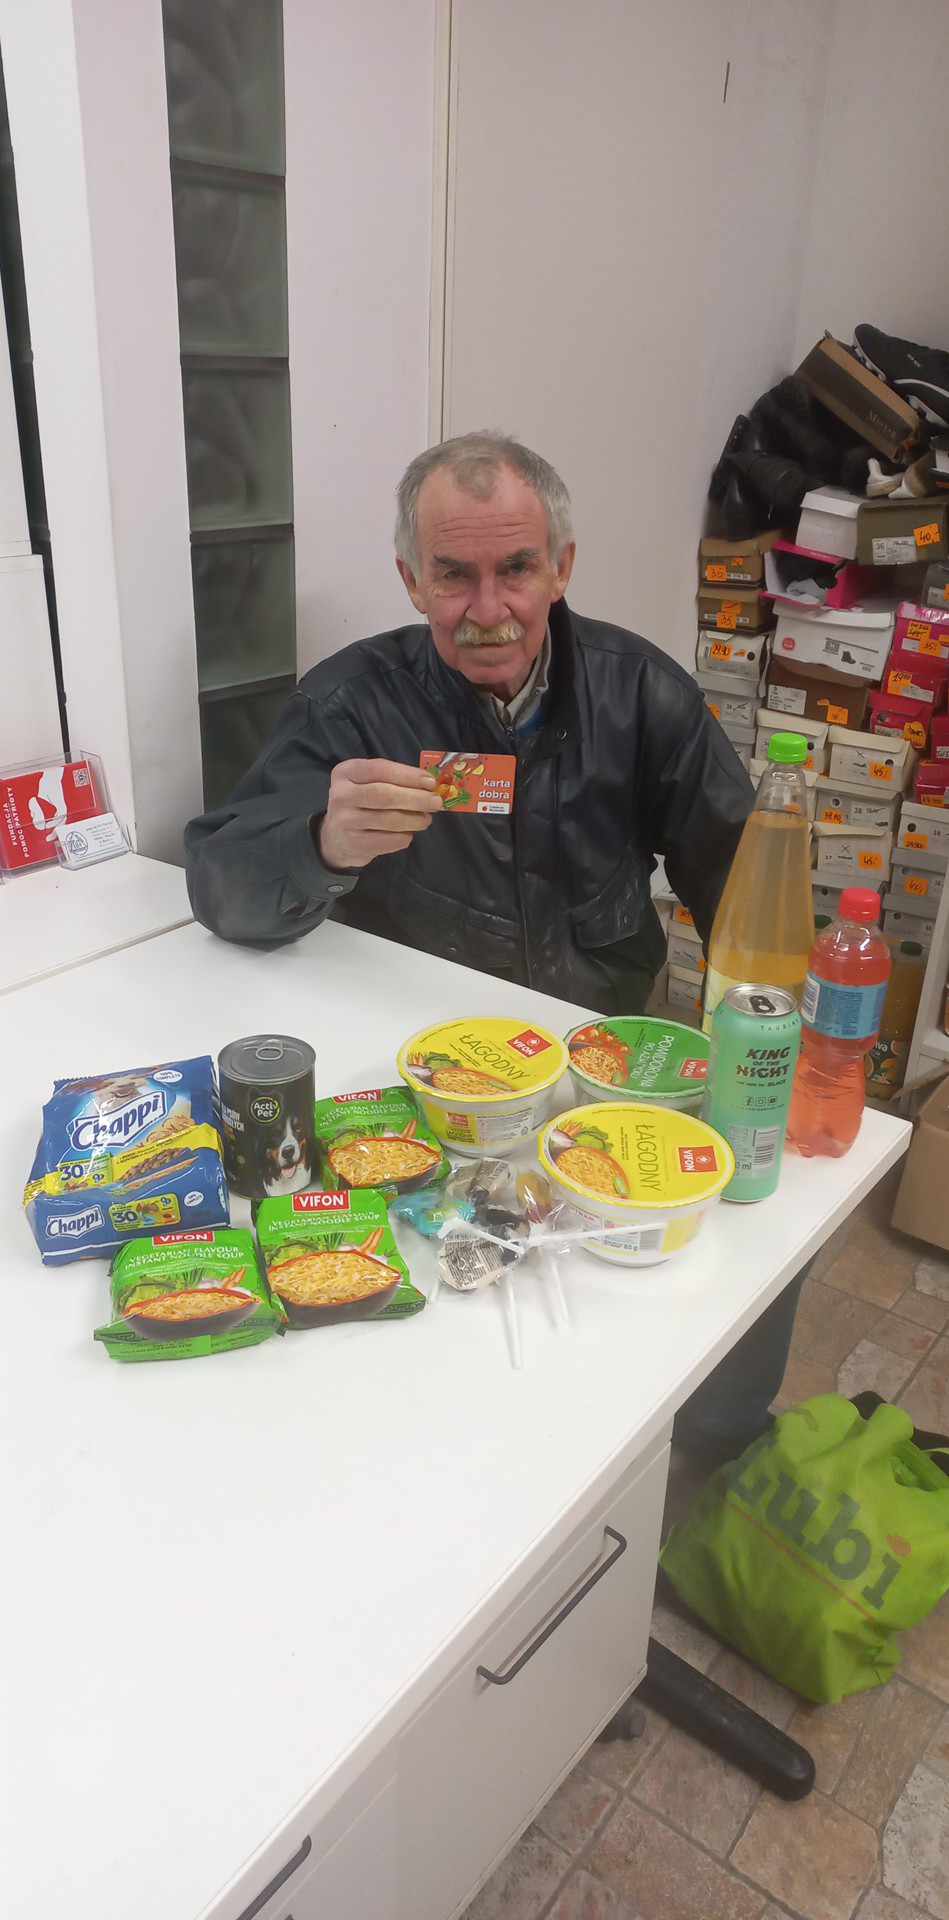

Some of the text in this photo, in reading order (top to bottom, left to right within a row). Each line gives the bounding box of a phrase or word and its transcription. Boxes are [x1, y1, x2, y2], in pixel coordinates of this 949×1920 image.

[483, 777, 511, 788] karta
[479, 789, 510, 799] dobra
[3, 803, 17, 846] FUNDACJA
[7, 787, 30, 858] POMOC PATRIOTY
[513, 1038, 536, 1056] VIFON
[746, 1046, 791, 1060] KING
[459, 1033, 530, 1081] ŁAGODNY
[735, 1064, 790, 1078] NIGHT
[337, 1092, 377, 1101] VIFON
[257, 1109, 275, 1118] Pet
[72, 1095, 161, 1149] Chappi
[635, 1123, 662, 1192] ŁAGODNY
[682, 1150, 696, 1172] VIFON
[60, 1164, 84, 1181] 30
[299, 1195, 344, 1208] VIFON
[47, 1209, 99, 1237] Chappi
[113, 1210, 138, 1223] 30
[159, 1233, 208, 1242] VIFON
